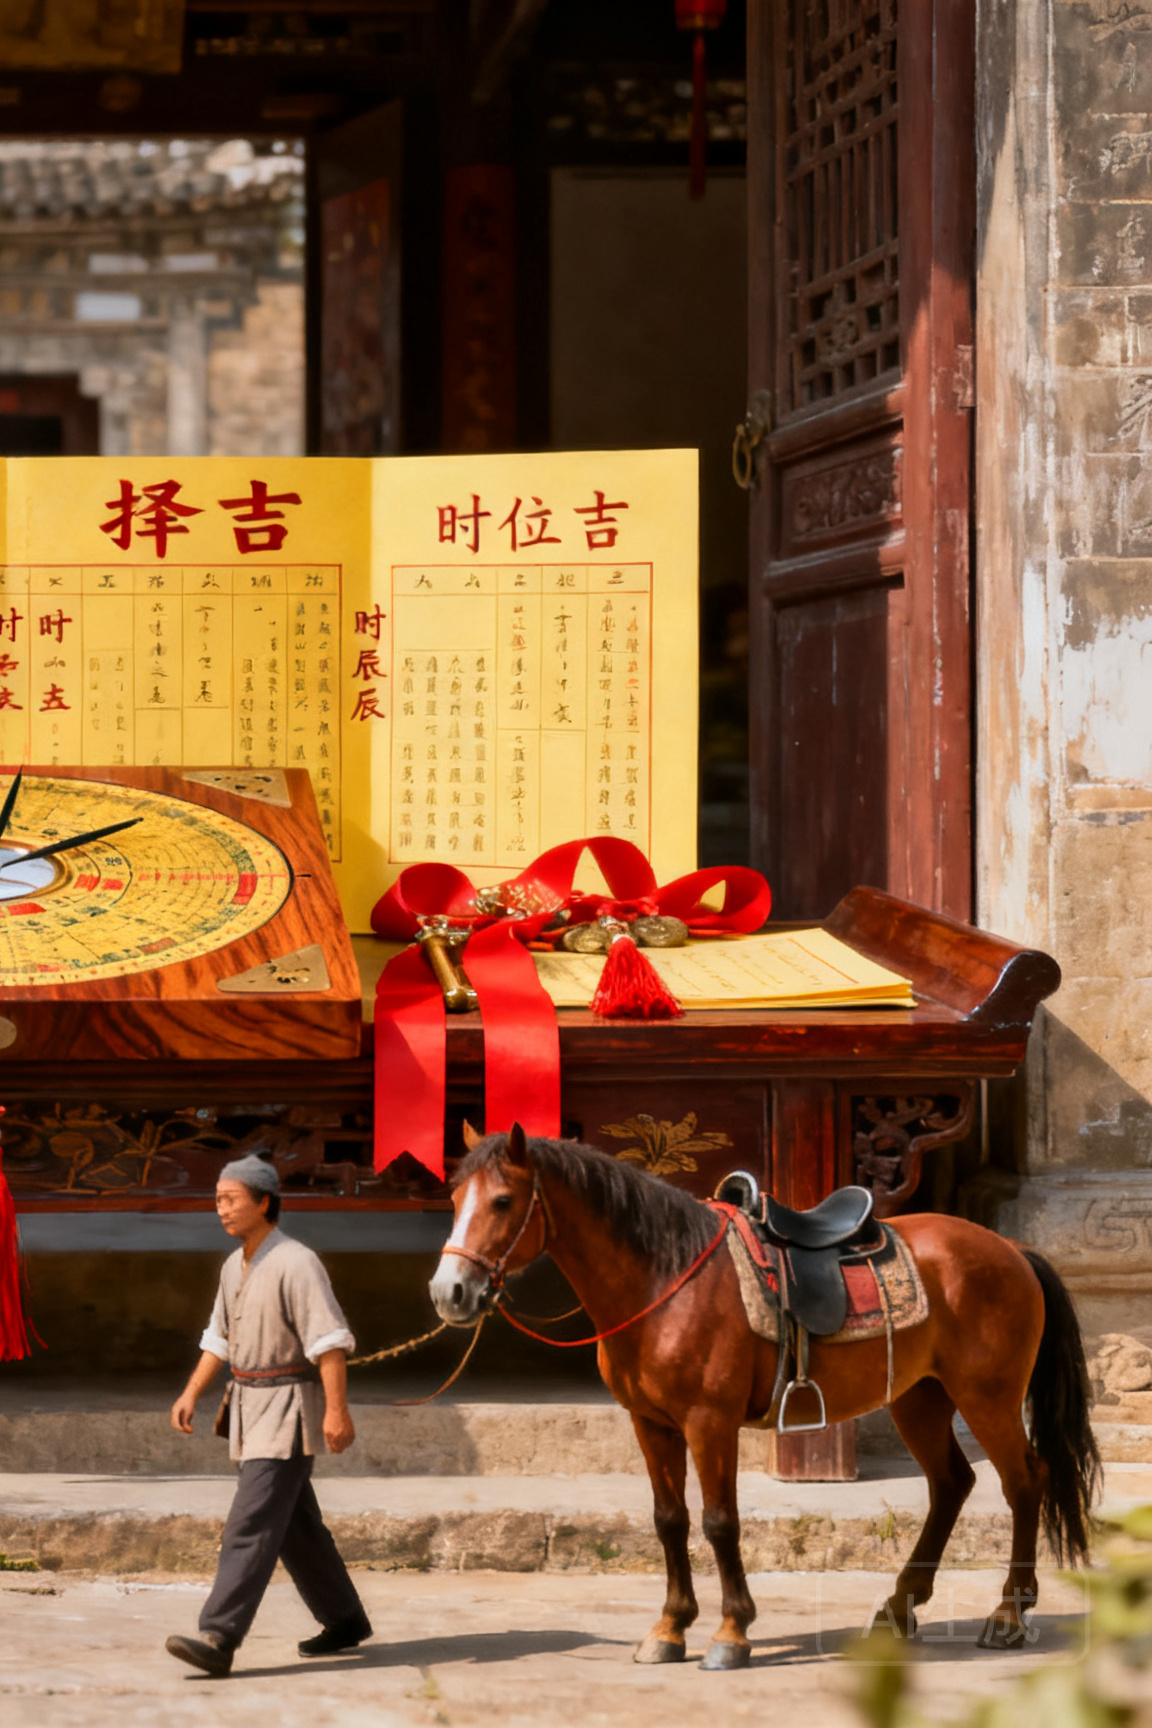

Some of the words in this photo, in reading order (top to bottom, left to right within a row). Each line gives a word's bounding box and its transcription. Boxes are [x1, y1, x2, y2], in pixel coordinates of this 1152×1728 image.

[100, 480, 304, 560] 择吉
[439, 491, 630, 555] 时位吉
